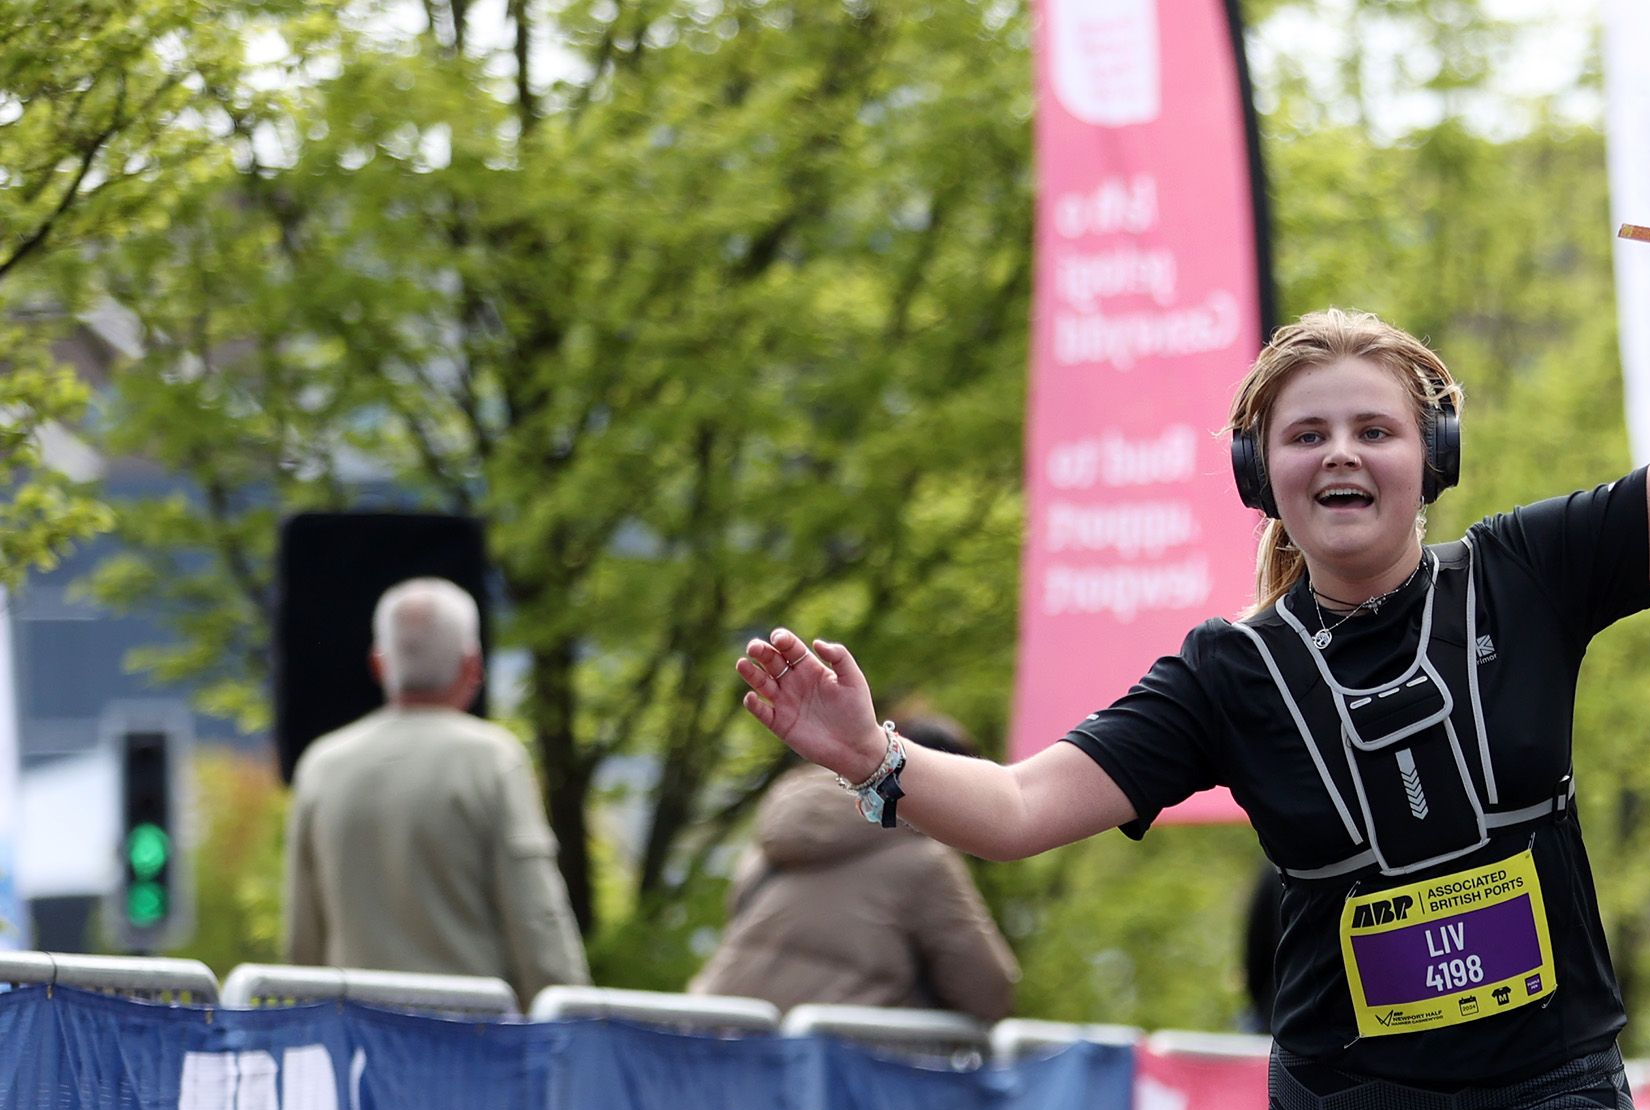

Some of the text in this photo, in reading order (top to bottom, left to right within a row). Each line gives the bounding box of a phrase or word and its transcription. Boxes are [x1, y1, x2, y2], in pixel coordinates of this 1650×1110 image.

[1428, 869, 1507, 899] ASSOCIATED
[1430, 876, 1524, 912] BRITISH PORTS
[1352, 895, 1414, 929] ABP
[1425, 922, 1464, 958] LIV
[1426, 954, 1484, 992] 4198
[1499, 993, 1508, 1003] M
[1393, 1013, 1424, 1021] NEWPORT
